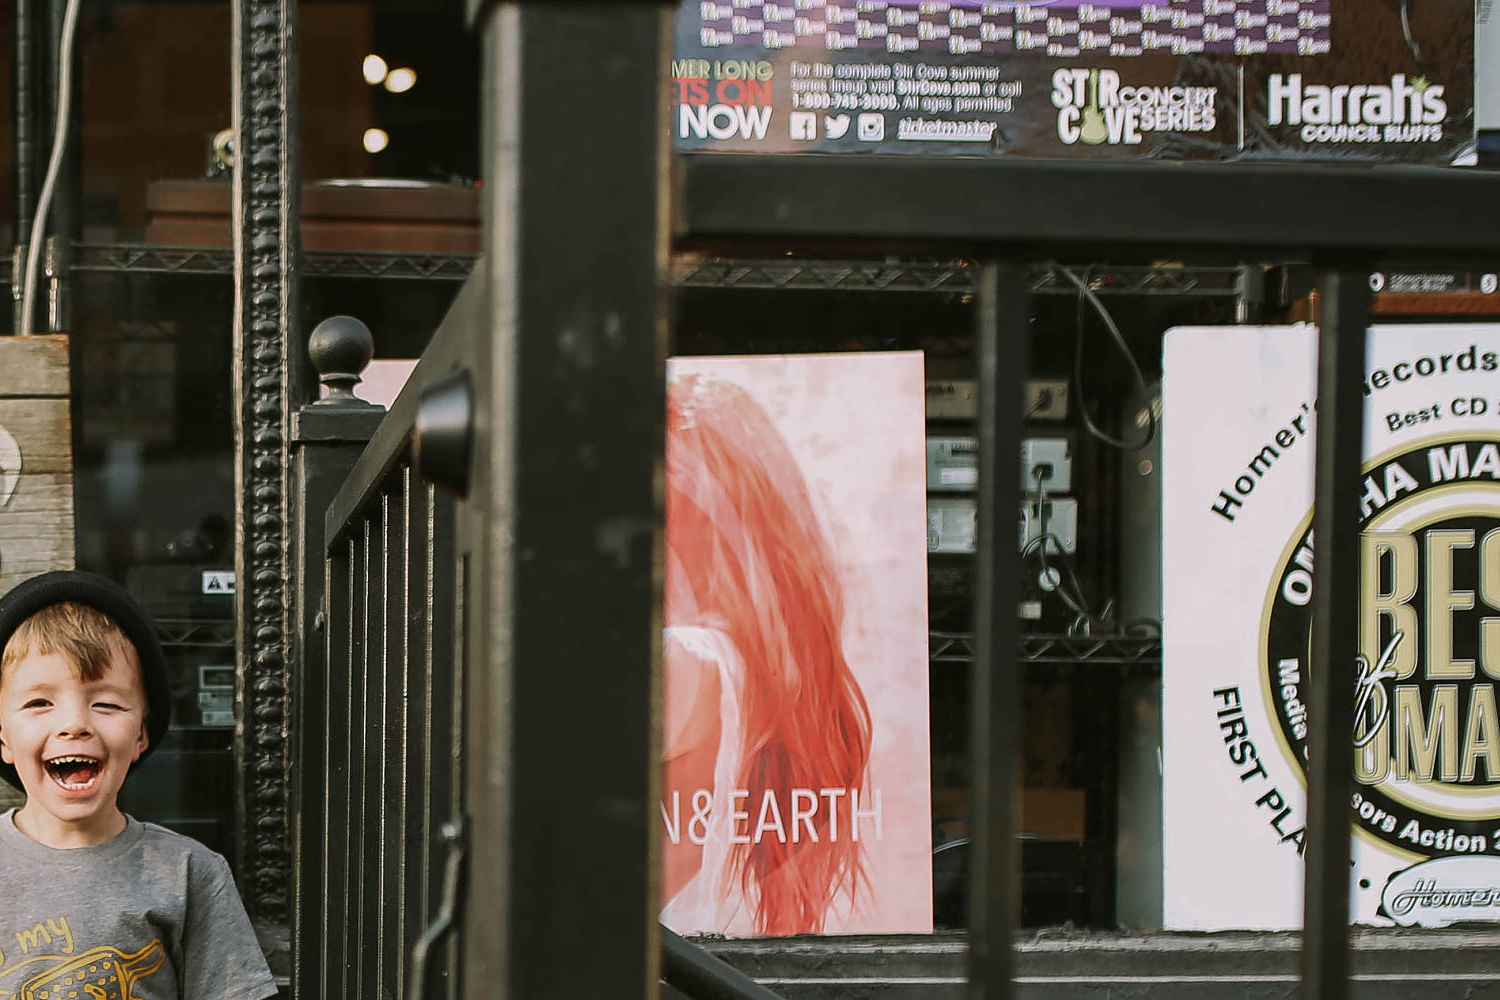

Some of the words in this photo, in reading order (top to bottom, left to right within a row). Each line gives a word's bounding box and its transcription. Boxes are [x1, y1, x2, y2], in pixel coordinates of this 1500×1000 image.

[671, 60, 711, 79] MER
[714, 60, 774, 80] LONG
[835, 63, 891, 80] complete
[716, 78, 773, 106] ON
[982, 82, 997, 96] or
[999, 81, 1022, 97] call
[1119, 87, 1217, 108] CONCERT
[902, 95, 919, 110] All
[921, 96, 952, 114] ages
[679, 103, 773, 140] NOW
[1140, 107, 1216, 131] SERIES
[1301, 125, 1381, 142] COUNCIL
[1384, 125, 1442, 142] BLUFFS
[1386, 403, 1440, 432] Best
[1451, 397, 1488, 416] CD
[1211, 399, 1318, 522] Homer'
[1363, 345, 1498, 396] ecords
[1428, 443, 1500, 484] MA
[1212, 683, 1269, 783] FIRST
[1255, 787, 1308, 856] PLA
[1399, 820, 1487, 852] Action
[15, 916, 75, 953] my
